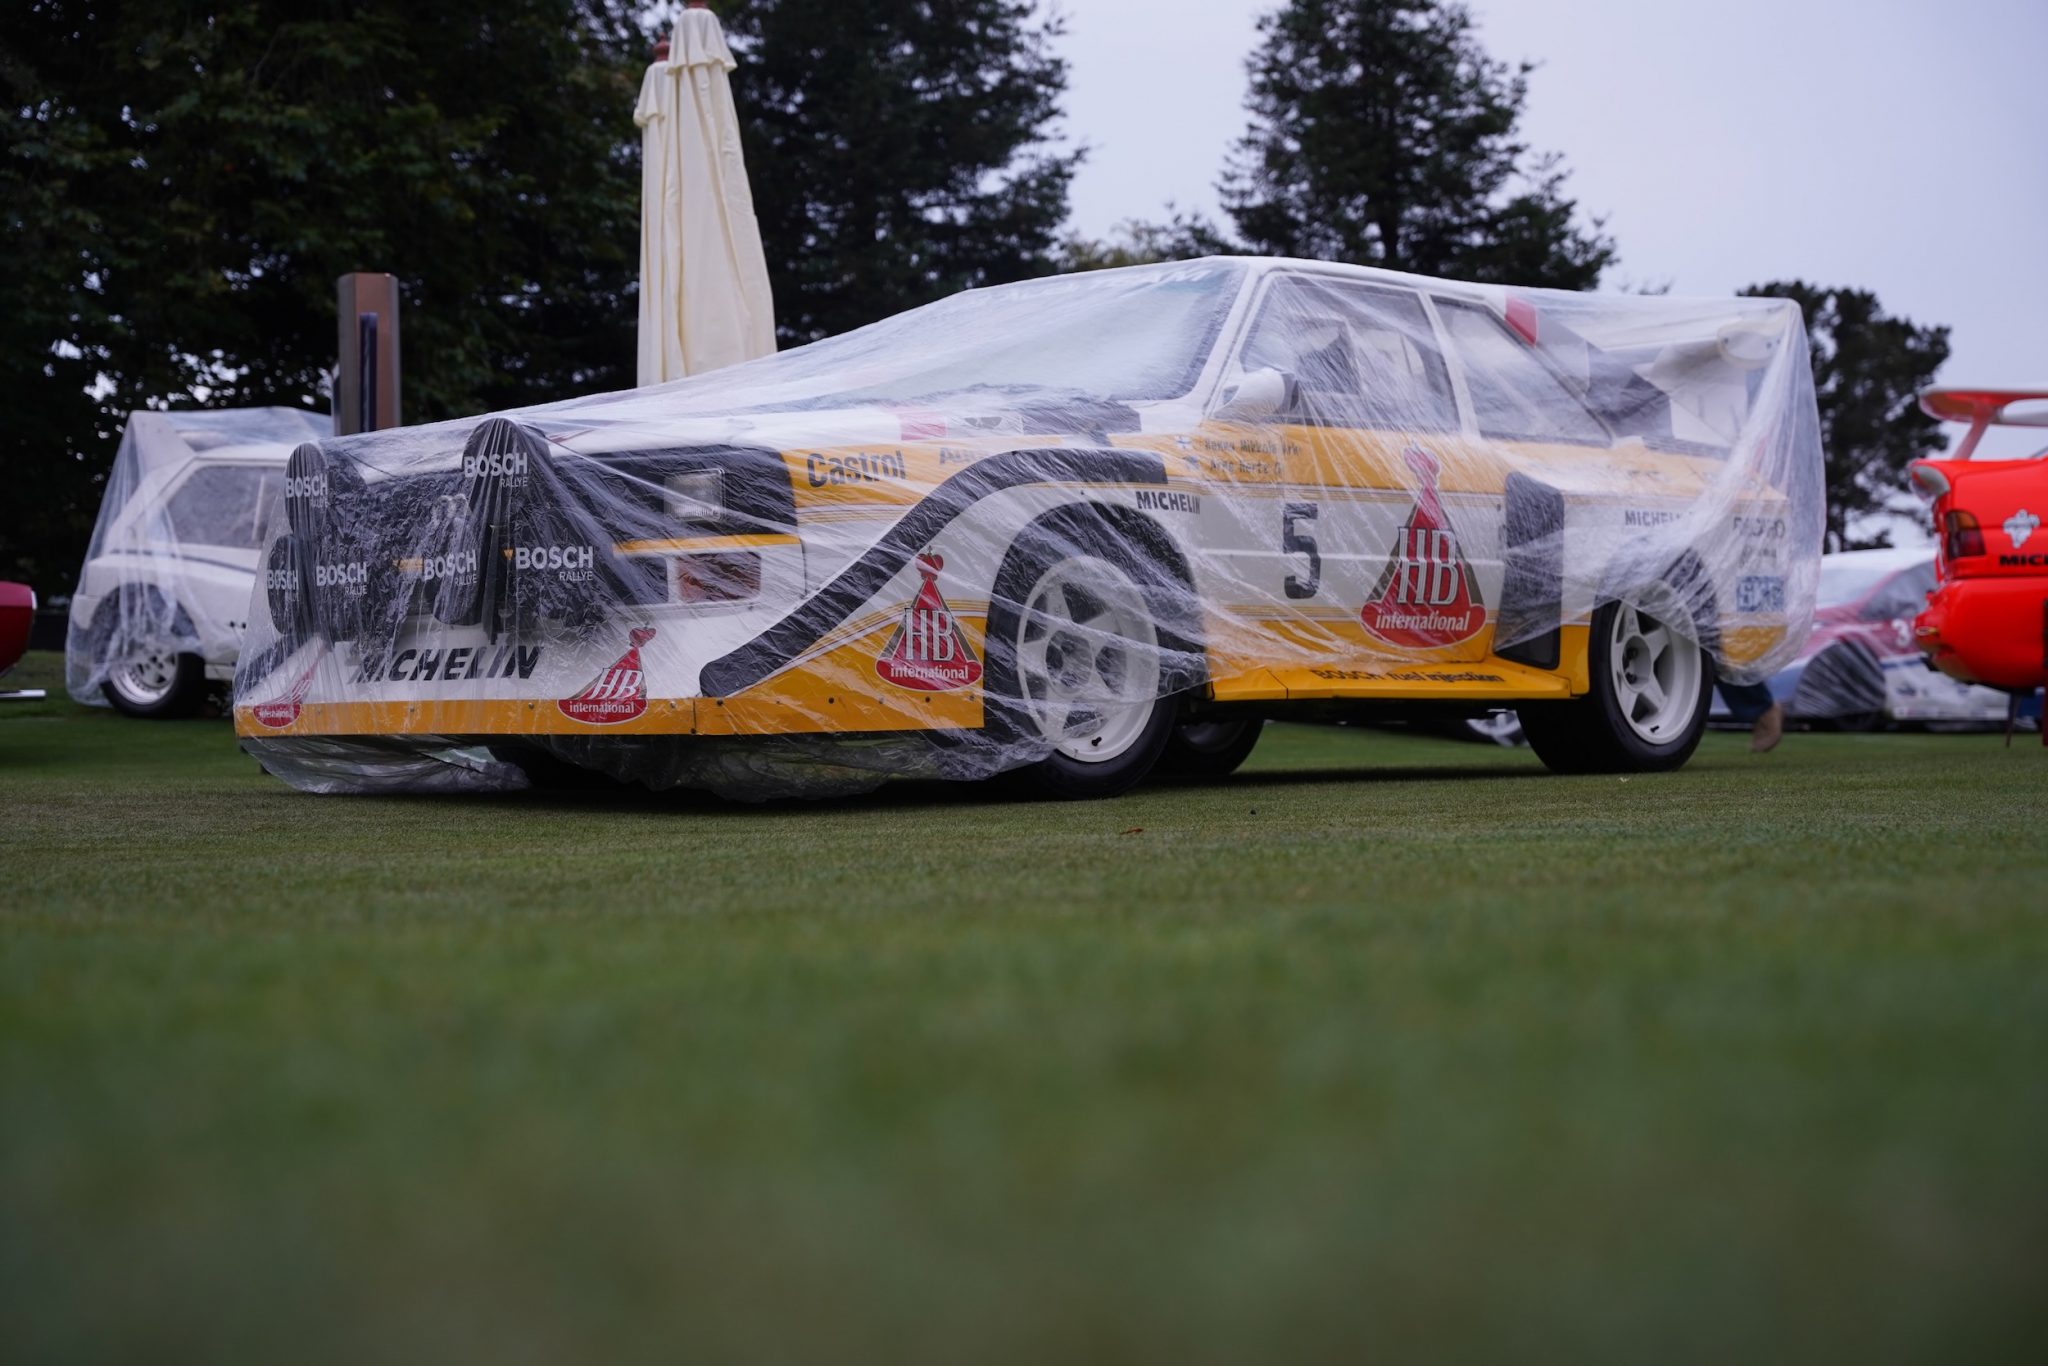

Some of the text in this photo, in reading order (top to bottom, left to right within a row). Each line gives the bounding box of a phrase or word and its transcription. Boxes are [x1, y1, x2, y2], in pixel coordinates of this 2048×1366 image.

[463, 452, 528, 478] BOSCH
[806, 449, 907, 488] Castrol
[285, 473, 328, 498] BOSCH
[500, 477, 528, 488] RALLYE
[515, 546, 594, 570] BOSCH
[1283, 502, 1321, 600] 5
[315, 562, 368, 586] BOSCH
[424, 550, 477, 581] BOSCH
[559, 570, 593, 582] RALLYE
[1398, 526, 1459, 605] HB
[267, 569, 299, 590] BOSCH
[455, 573, 478, 587] RALLYE
[1375, 610, 1471, 632] international
[904, 607, 955, 662] HB
[890, 663, 969, 680] international
[587, 668, 644, 701] HB
[569, 700, 635, 713] international
